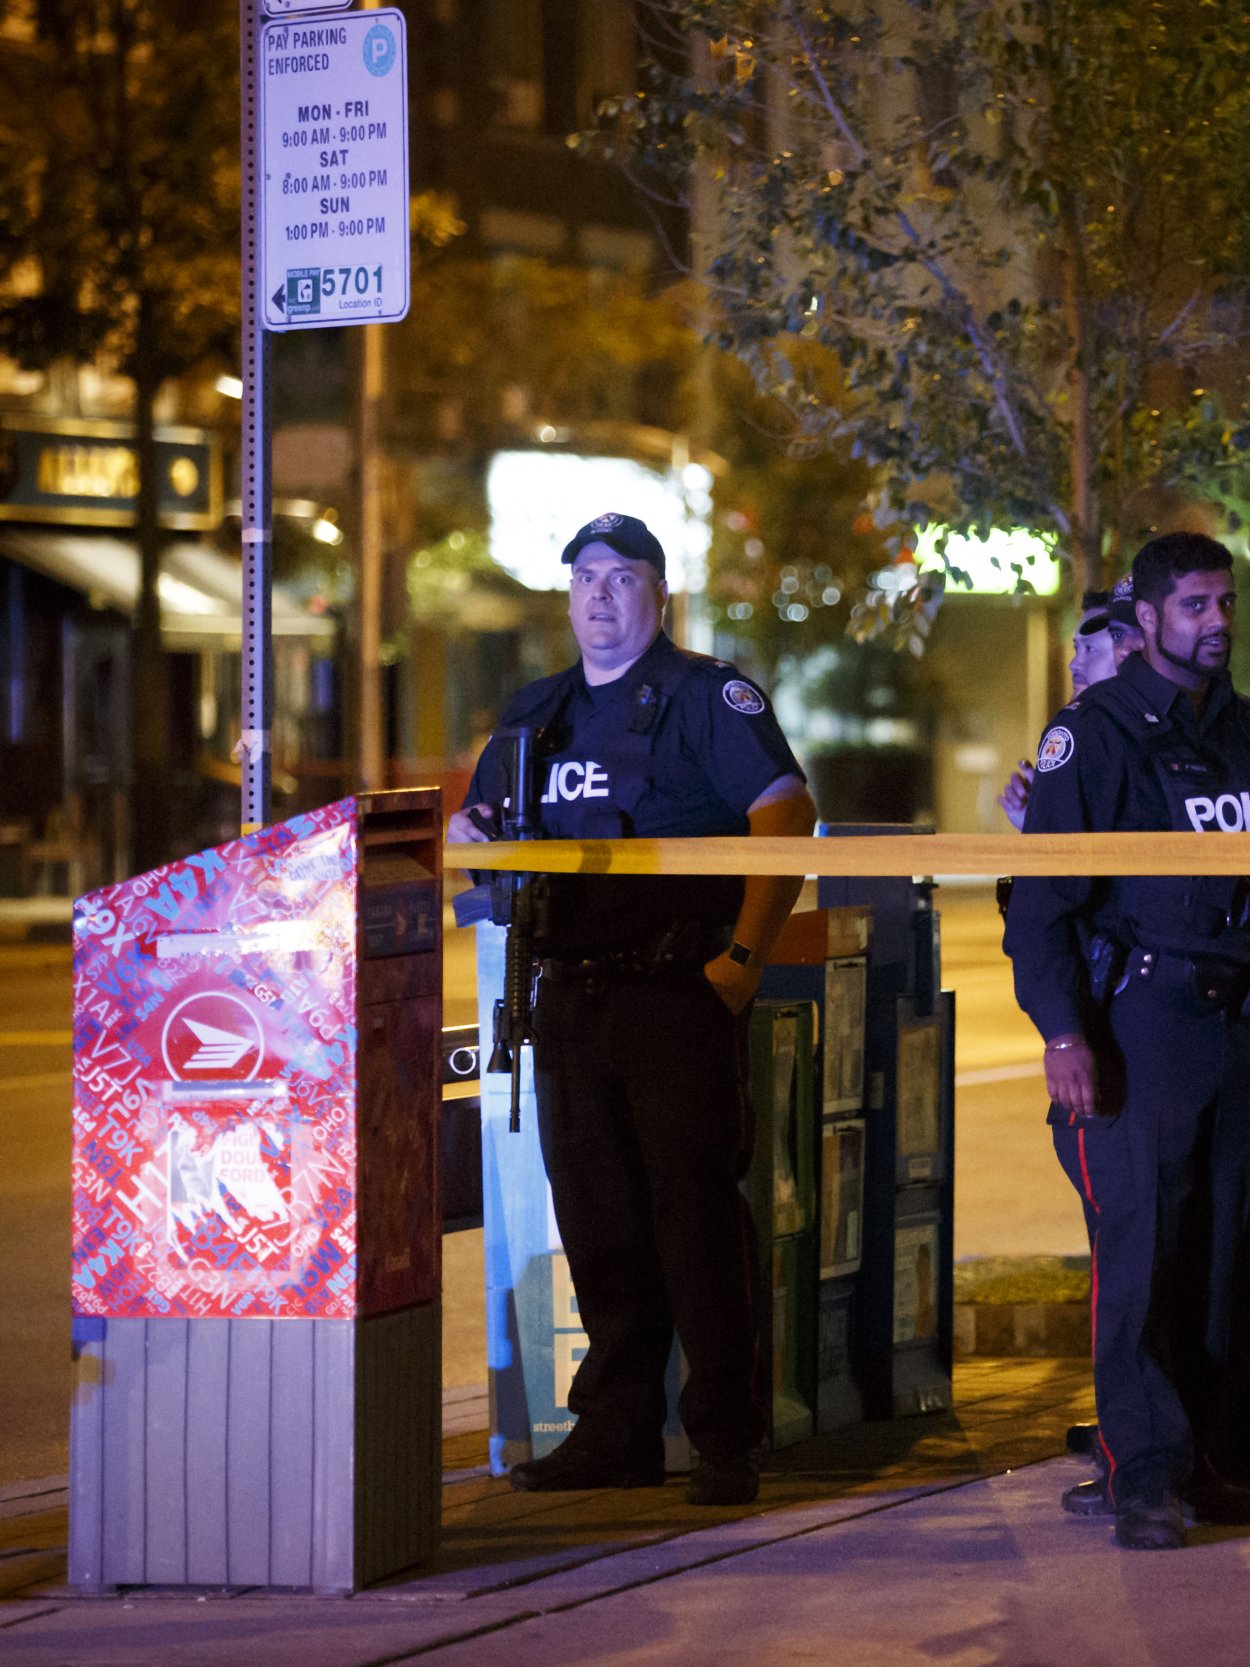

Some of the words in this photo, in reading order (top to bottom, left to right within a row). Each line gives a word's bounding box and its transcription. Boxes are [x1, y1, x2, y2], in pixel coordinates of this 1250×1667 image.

[268, 33, 289, 51] PAY
[293, 27, 347, 49] PARKING
[371, 38, 389, 64] P
[268, 53, 329, 75] ENFORCED
[298, 103, 331, 123] MON
[345, 100, 369, 118] FRI
[282, 130, 307, 148] 9:00
[311, 127, 330, 145] AM
[340, 125, 365, 143] 9:00
[368, 122, 387, 140] PM
[320, 149, 349, 168] SAT
[282, 177, 308, 195] 8:00
[311, 174, 330, 192] AM
[340, 171, 366, 189] 9:00
[369, 169, 388, 187] PM
[320, 196, 350, 215] SUN
[285, 224, 308, 241] 1:00
[311, 221, 329, 239] PM
[339, 219, 364, 237] 9:00
[367, 217, 386, 234] PM
[287, 270, 309, 278] MOBILE
[321, 265, 382, 297] 5701
[339, 299, 371, 310] Location
[374, 297, 383, 307] ID
[80, 1066, 123, 1102] J5T
[97, 1114, 144, 1168] T9K
[102, 1205, 147, 1257] T9K
[236, 1226, 281, 1263] J5T
